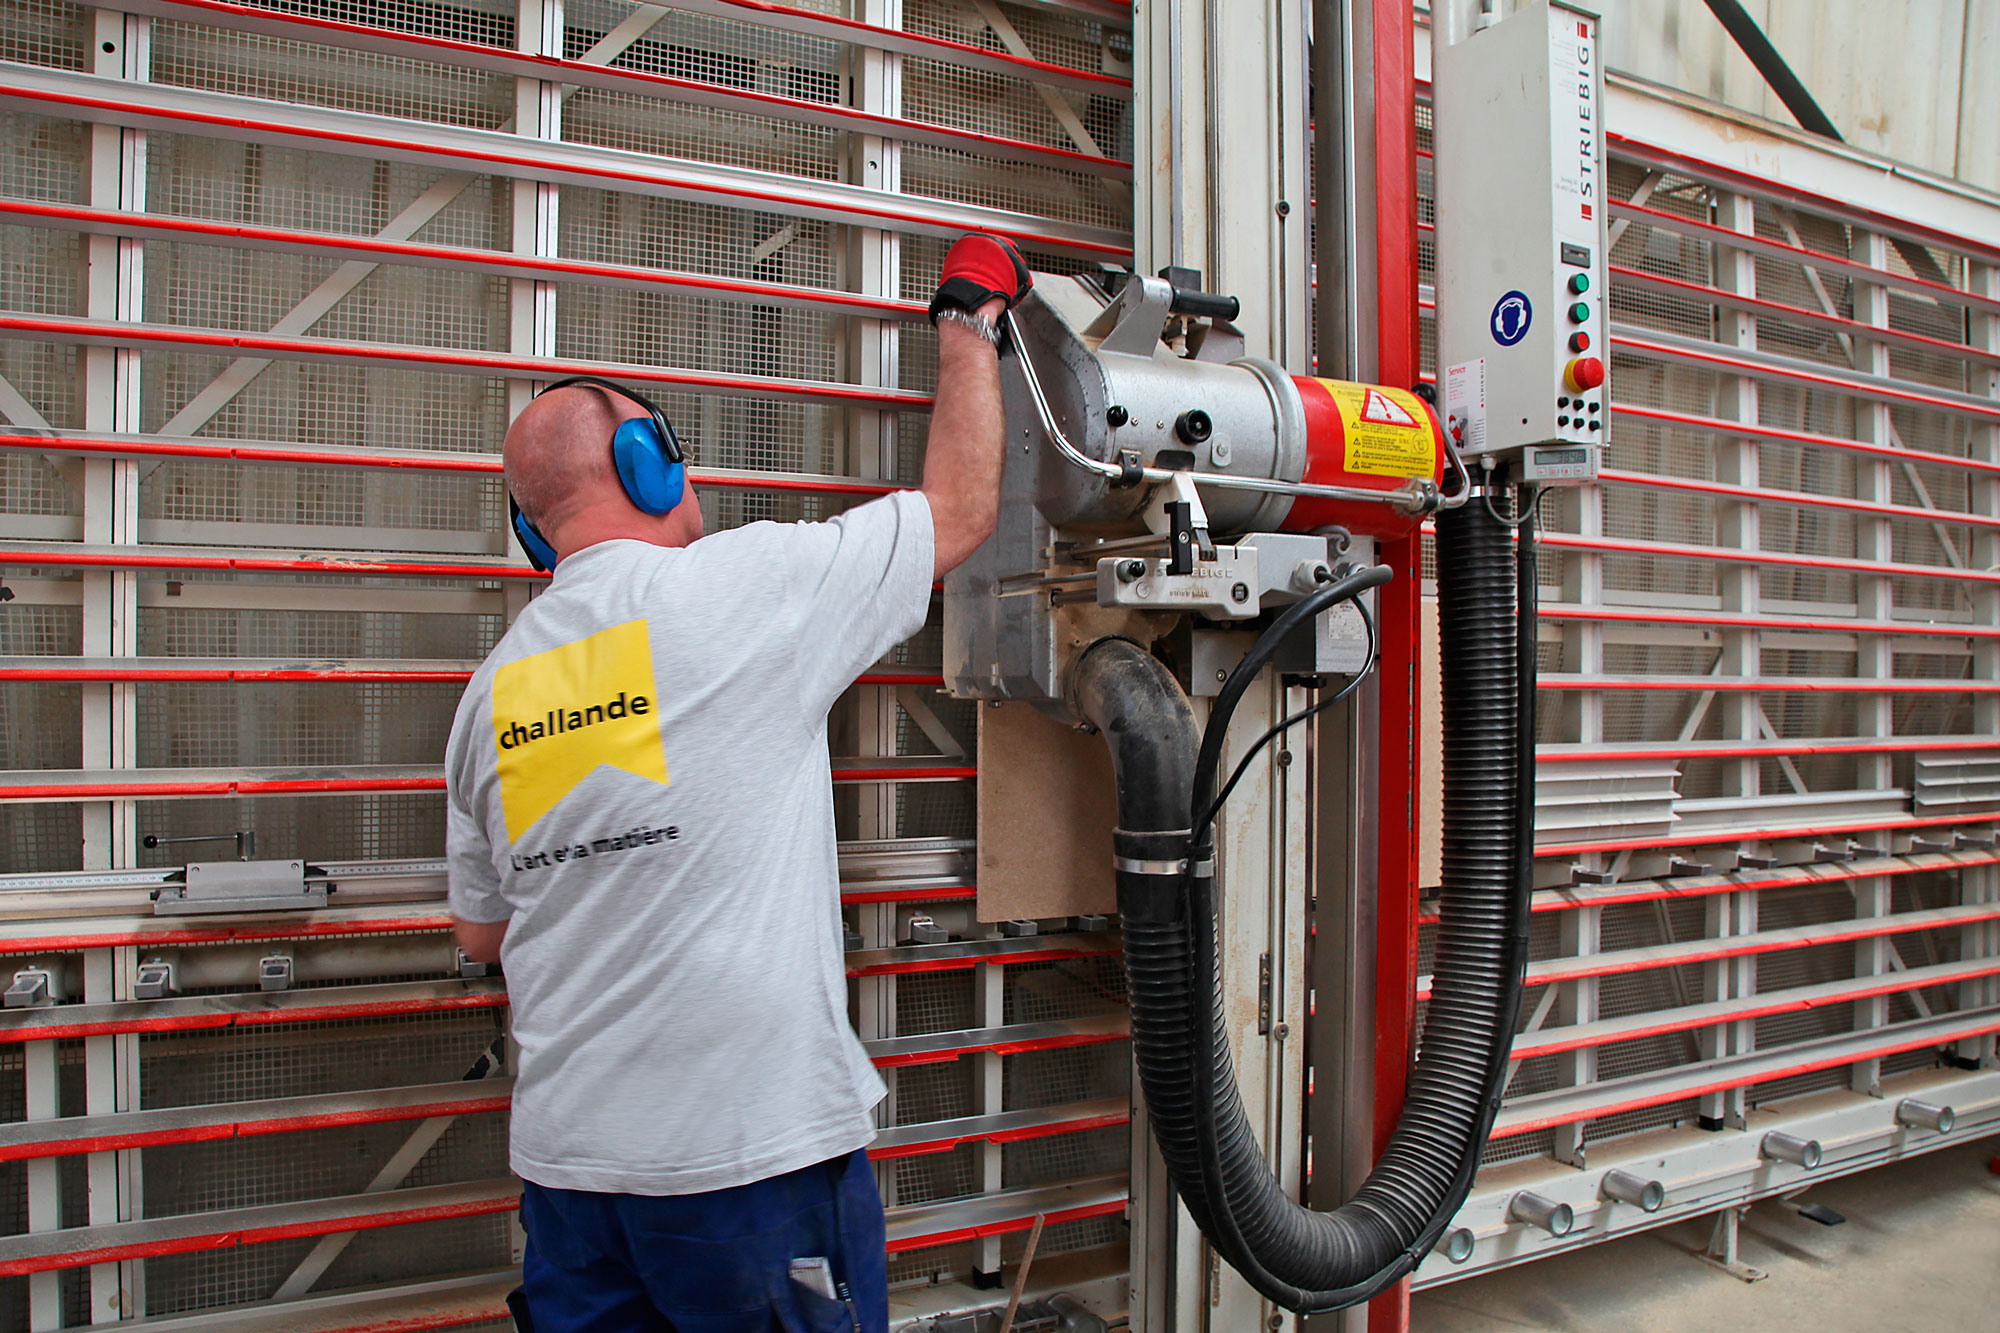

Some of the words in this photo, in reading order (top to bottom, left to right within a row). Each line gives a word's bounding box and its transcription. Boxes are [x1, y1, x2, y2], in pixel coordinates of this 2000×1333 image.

[1578, 45, 1592, 198] STRIEBIG
[1155, 567, 1225, 578] SEBIG
[500, 691, 650, 750] challande
[509, 851, 552, 872] L'art
